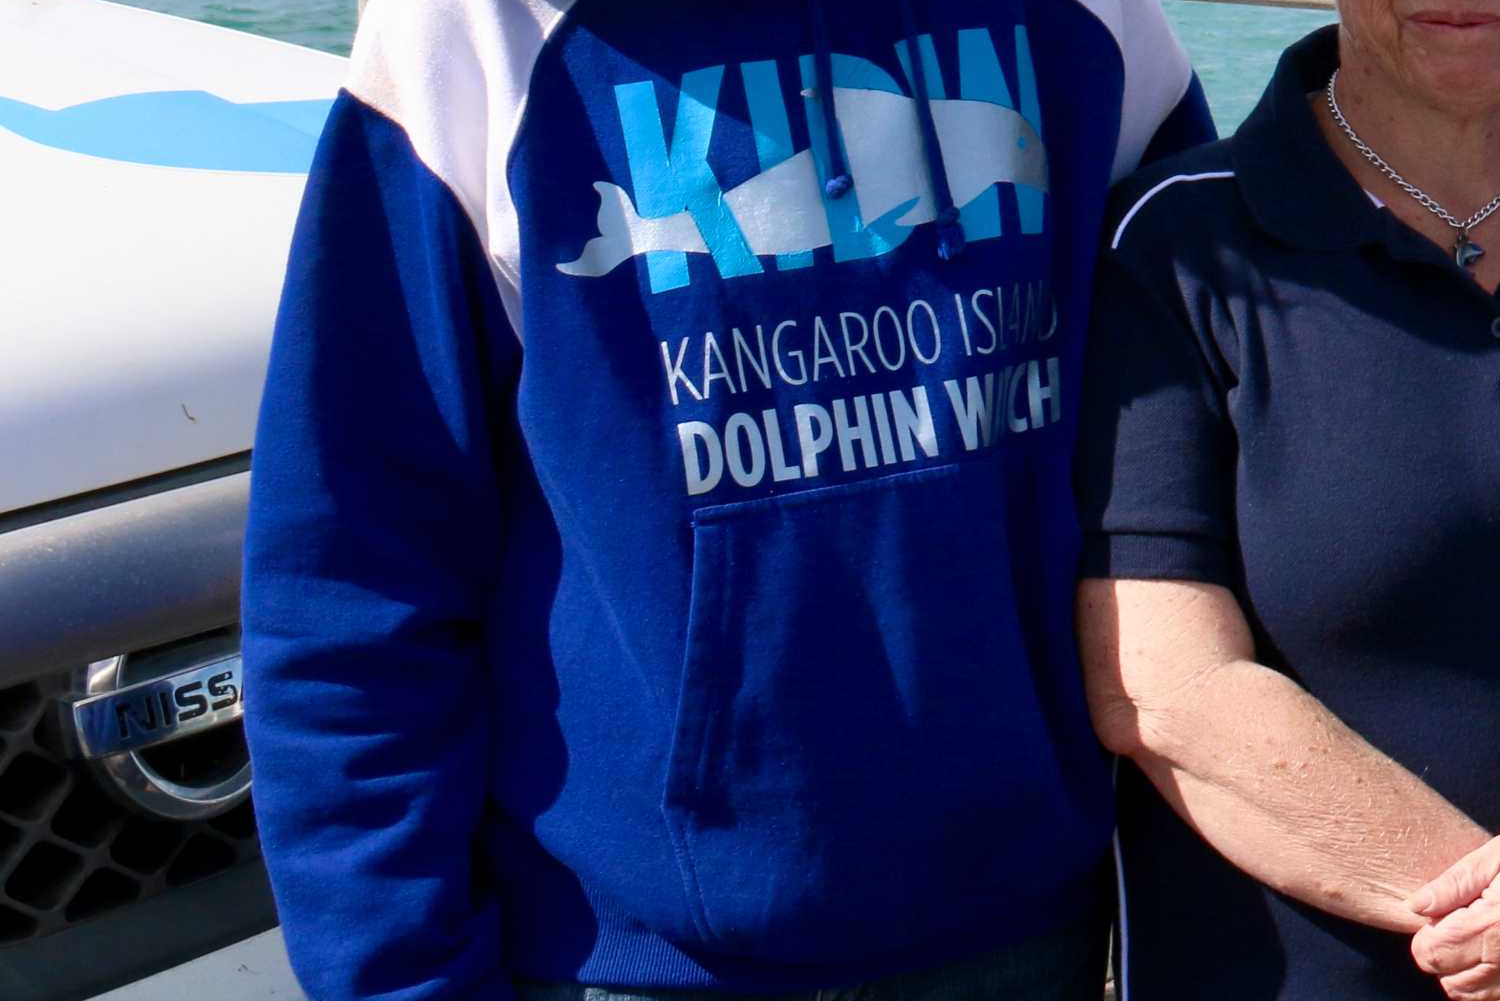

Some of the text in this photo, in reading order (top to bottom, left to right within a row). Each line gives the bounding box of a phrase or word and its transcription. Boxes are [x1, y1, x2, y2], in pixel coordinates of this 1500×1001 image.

[614, 25, 1044, 294] KIDW
[660, 299, 941, 405] KANGAROO
[677, 386, 939, 496] DOLPHIN
[115, 670, 243, 738] NISS
